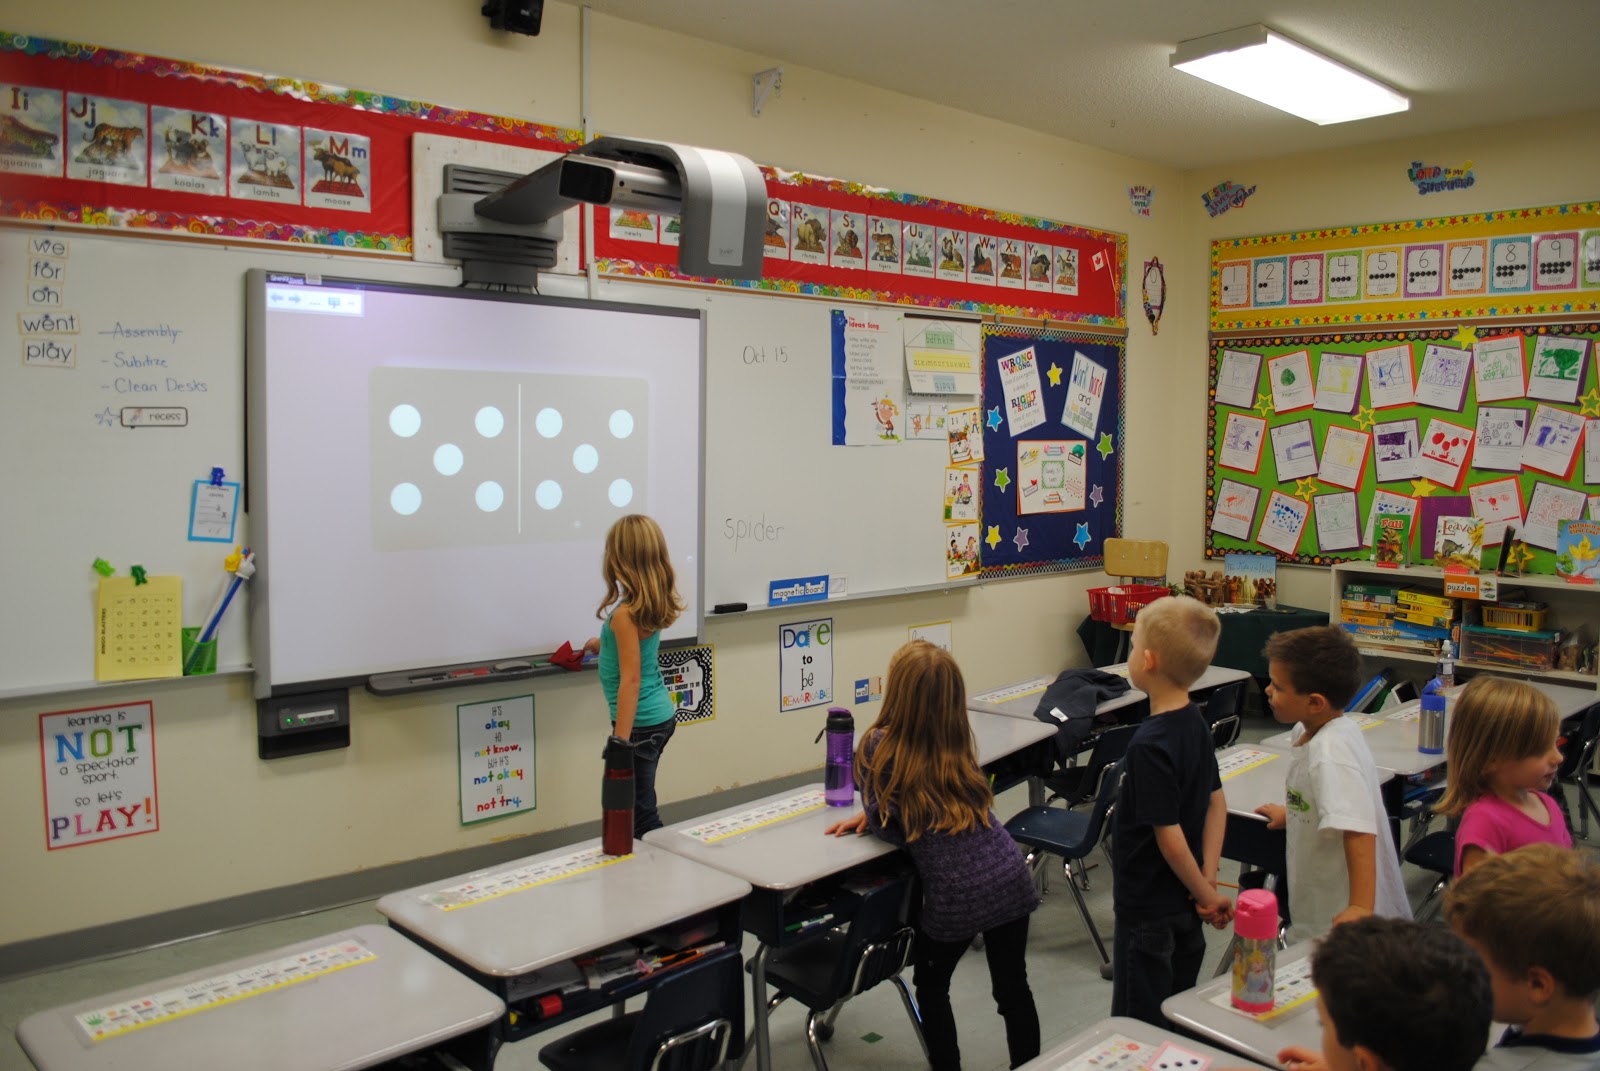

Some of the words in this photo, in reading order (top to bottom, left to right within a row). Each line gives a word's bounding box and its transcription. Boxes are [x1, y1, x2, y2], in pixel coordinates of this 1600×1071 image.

[1407, 166, 1441, 182] LORD
[174, 178, 206, 190] koalas
[1418, 176, 1474, 195] SHEPHERD
[252, 188, 281, 198] lambs
[324, 197, 352, 206] moose
[1201, 180, 1232, 207] JESUS
[34, 239, 65, 256] we
[1461, 247, 1472, 265] 7
[1505, 244, 1516, 262] 8
[1551, 240, 1561, 258] 9
[1337, 257, 1349, 273] 4
[1378, 253, 1388, 270] 5
[1419, 250, 1429, 268] 6
[34, 261, 61, 279] for
[1265, 264, 1275, 280] 2
[1302, 260, 1310, 277] 3
[1502, 278, 1518, 288] eight
[32, 289, 59, 304] on
[23, 315, 75, 332] went
[848, 321, 866, 329] Ideas
[867, 322, 880, 331] Song
[27, 342, 71, 363] play
[743, 345, 765, 365] Oct
[775, 346, 788, 363] 15
[1001, 351, 1033, 371] WRONG
[115, 377, 157, 394] Clean
[166, 377, 208, 392] Desks
[1011, 390, 1037, 408] RIGHT
[1078, 393, 1091, 406] and
[149, 412, 182, 421] recess
[723, 512, 785, 552] spider
[1381, 519, 1403, 530] Fall
[1442, 520, 1478, 536] Leaves
[773, 587, 804, 601] magnetic
[805, 582, 825, 595] board
[1406, 593, 1418, 601] 175
[1447, 583, 1476, 594] puzzles
[783, 623, 831, 649] Dare
[802, 655, 813, 664] to
[801, 668, 814, 690] be
[67, 713, 112, 727] learning
[118, 711, 127, 721] is
[485, 718, 510, 731] okay
[55, 724, 142, 763] NOT
[494, 731, 502, 743] to
[474, 745, 491, 758] not
[493, 743, 522, 755] know,
[59, 766, 68, 776] a
[75, 756, 139, 773] spectator
[82, 770, 119, 784] sport.
[474, 770, 494, 785] not
[497, 768, 523, 780] okay
[496, 784, 503, 795] to
[74, 796, 90, 807] so
[97, 790, 122, 803] let's
[477, 797, 496, 812] not
[499, 795, 522, 808] try.
[51, 797, 152, 840] PLAY!
